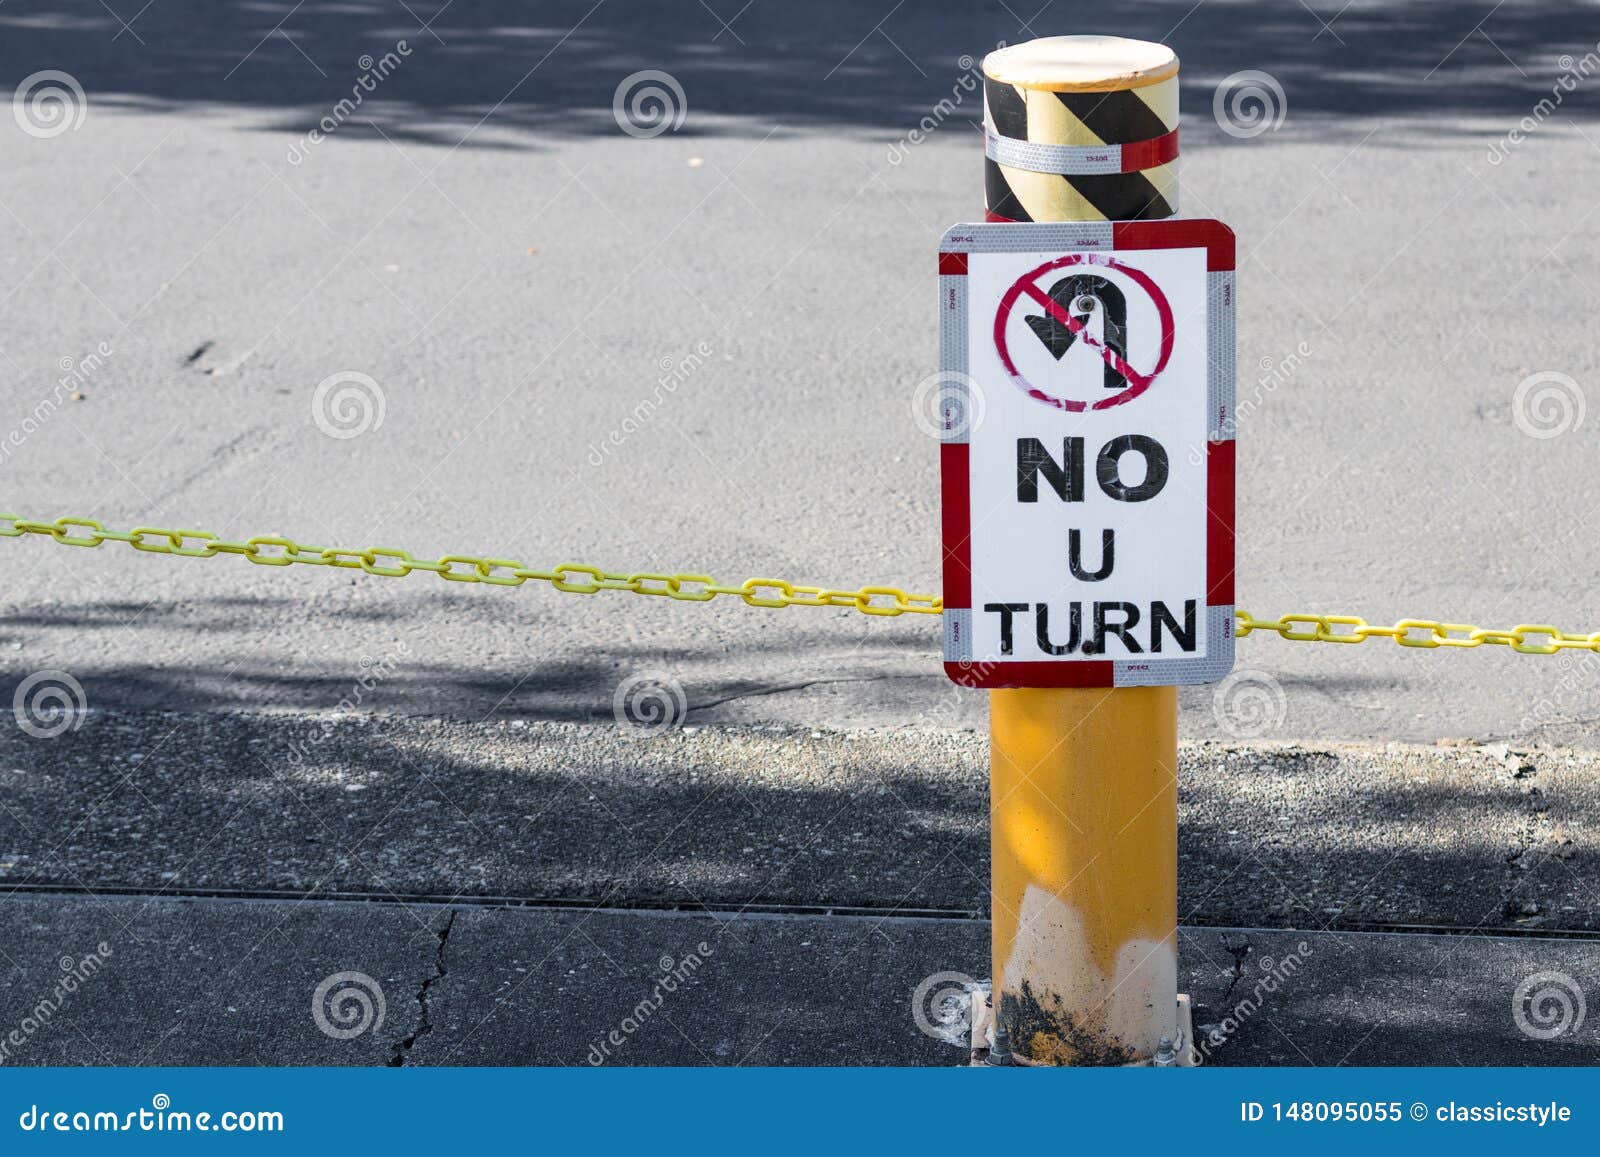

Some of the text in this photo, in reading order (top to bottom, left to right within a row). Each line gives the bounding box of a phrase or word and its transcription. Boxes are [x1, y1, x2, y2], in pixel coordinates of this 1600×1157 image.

[1016, 434, 1169, 503] NO
[1068, 528, 1115, 582] U
[984, 599, 1197, 656] TURN
